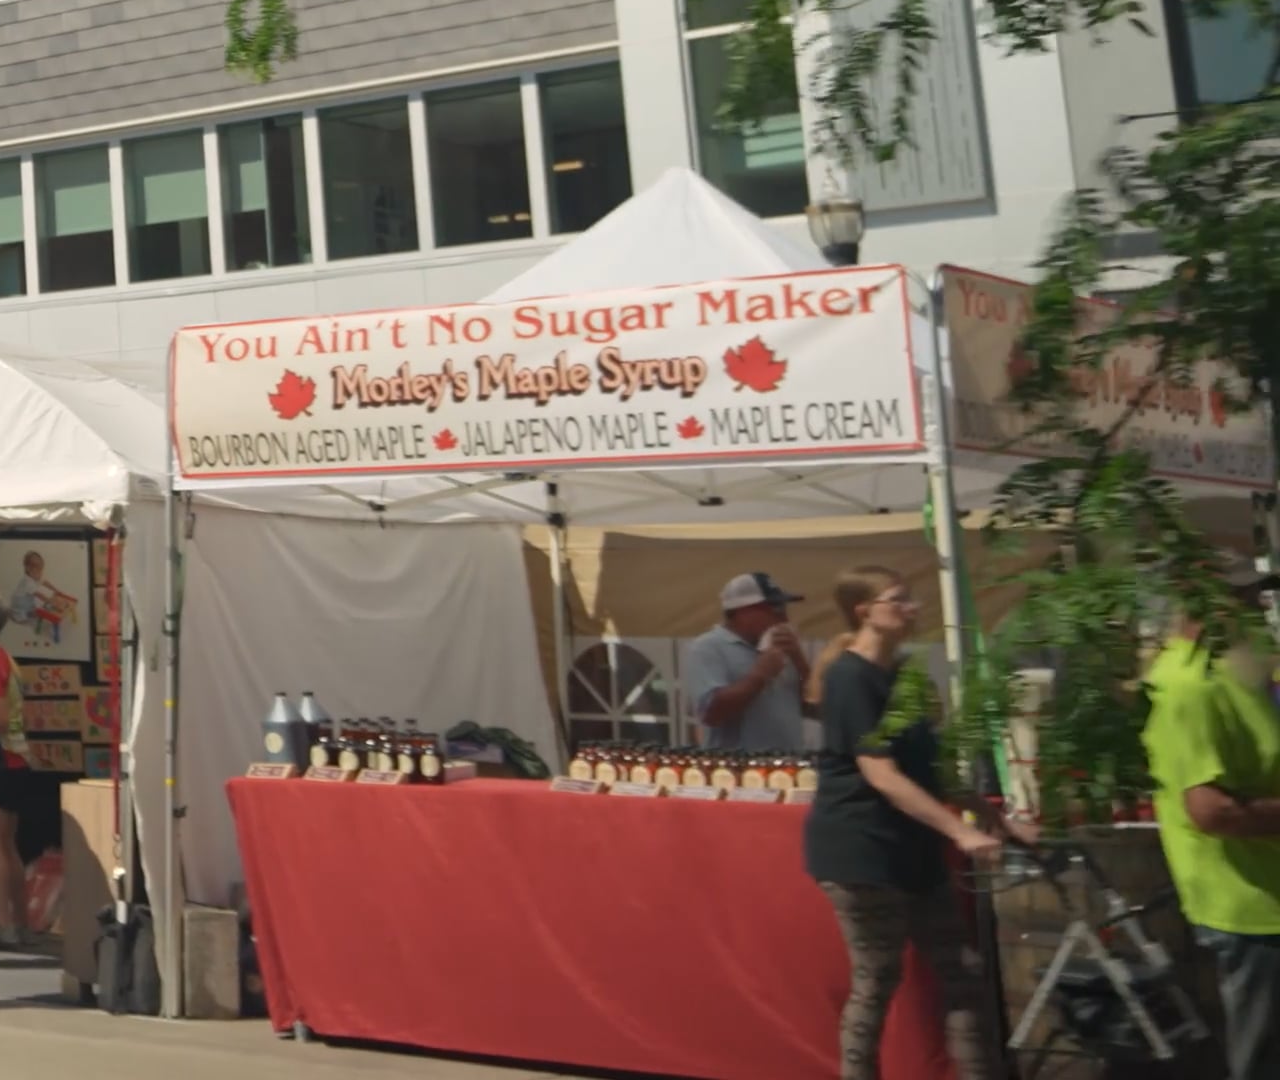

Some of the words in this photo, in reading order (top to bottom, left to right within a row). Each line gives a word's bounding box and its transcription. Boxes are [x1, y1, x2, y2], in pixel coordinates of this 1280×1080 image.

[199, 334, 277, 363] You
[296, 318, 406, 356] Ain't
[427, 312, 492, 346] No
[512, 301, 674, 344] Sugar
[696, 284, 886, 326] Maker
[330, 359, 469, 412] Morley's
[476, 351, 591, 405] Maple
[598, 346, 708, 401] Syrup
[461, 415, 583, 457] JALAPENO
[588, 411, 671, 451] MAPLE
[710, 402, 798, 445] MAPLE
[803, 397, 904, 441] CREAM
[188, 431, 292, 468] BOURBON
[295, 429, 349, 464] AGED
[355, 424, 427, 461] MAPLE
